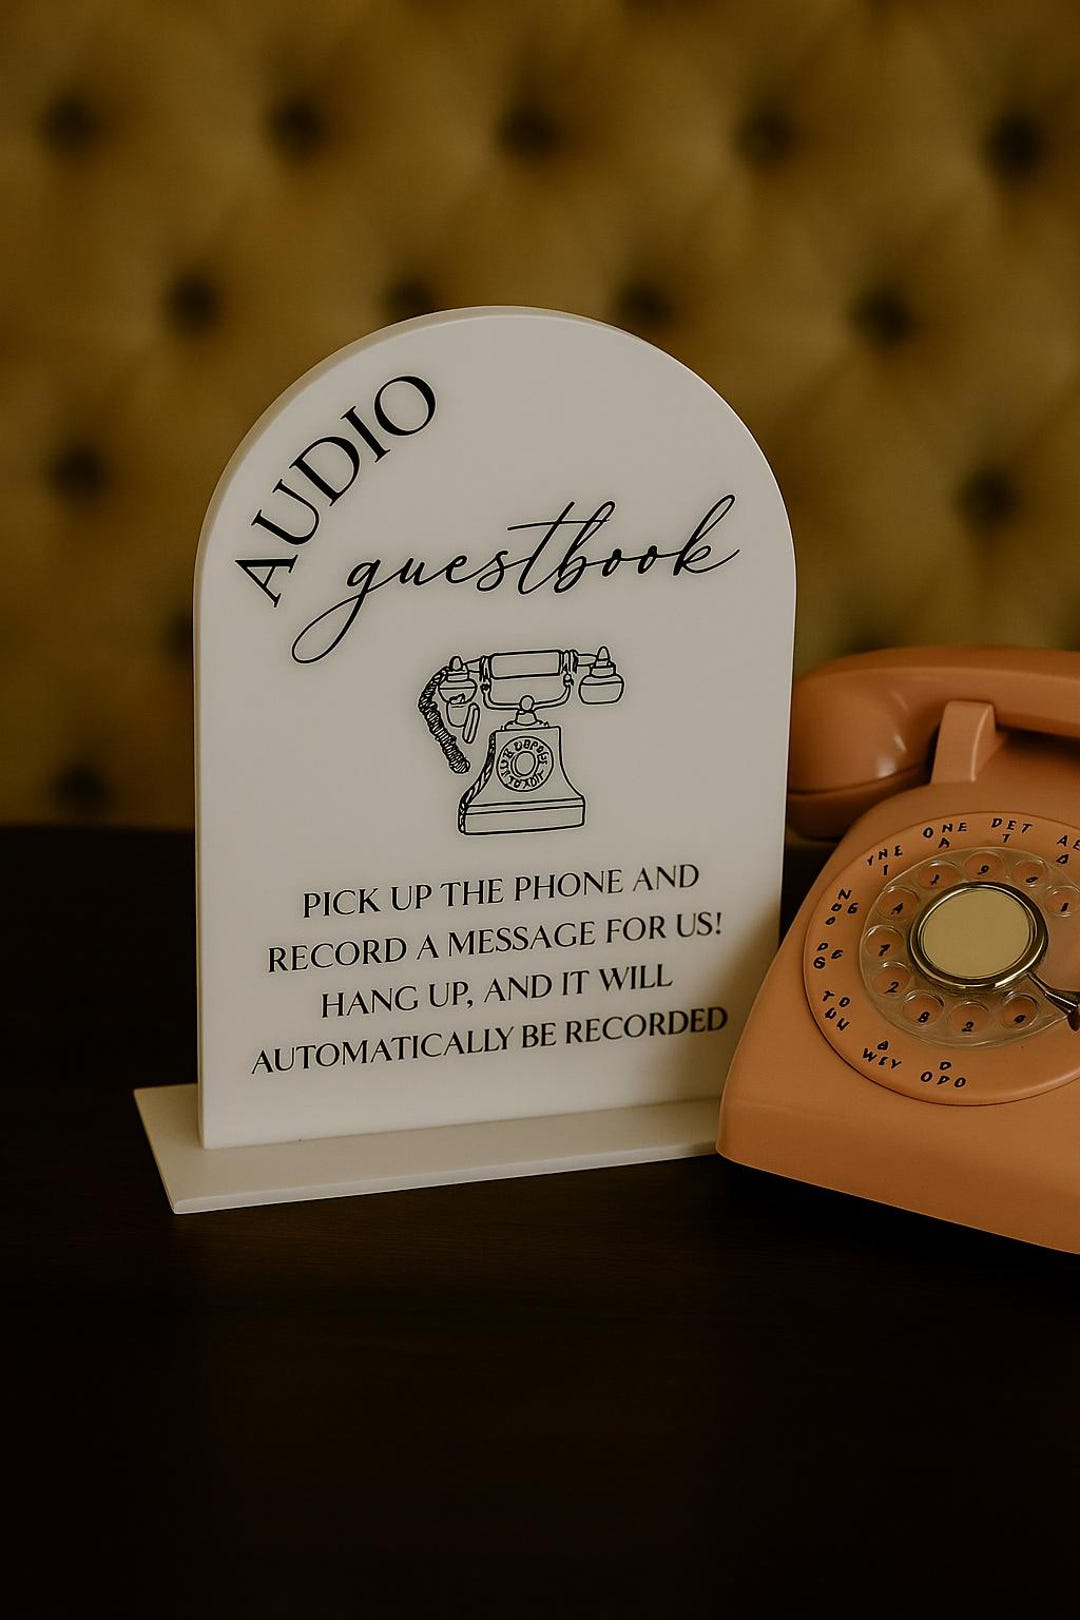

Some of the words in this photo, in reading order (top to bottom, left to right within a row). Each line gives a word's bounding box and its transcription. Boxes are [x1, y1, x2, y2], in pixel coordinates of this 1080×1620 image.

[235, 375, 436, 608] AUDIO
[291, 494, 741, 664] guestbook
[303, 887, 381, 919] PICK
[391, 884, 432, 912] UP
[439, 878, 504, 908] THE
[514, 869, 624, 903] PHONE
[632, 863, 700, 893] AND
[268, 937, 407, 973] RECORD
[416, 934, 439, 961] A
[448, 920, 596, 957] MESSAGE
[606, 915, 667, 945] FOR
[676, 911, 722, 939] US!
[321, 983, 419, 1019] HANG
[428, 981, 474, 1009] UP,
[483, 974, 553, 1003] AND
[562, 969, 590, 996] IT
[598, 963, 673, 992] WILL
[251, 1026, 515, 1075] AUTOMATICALLY
[521, 1022, 557, 1049] BE
[565, 1006, 729, 1044] RECORDED
